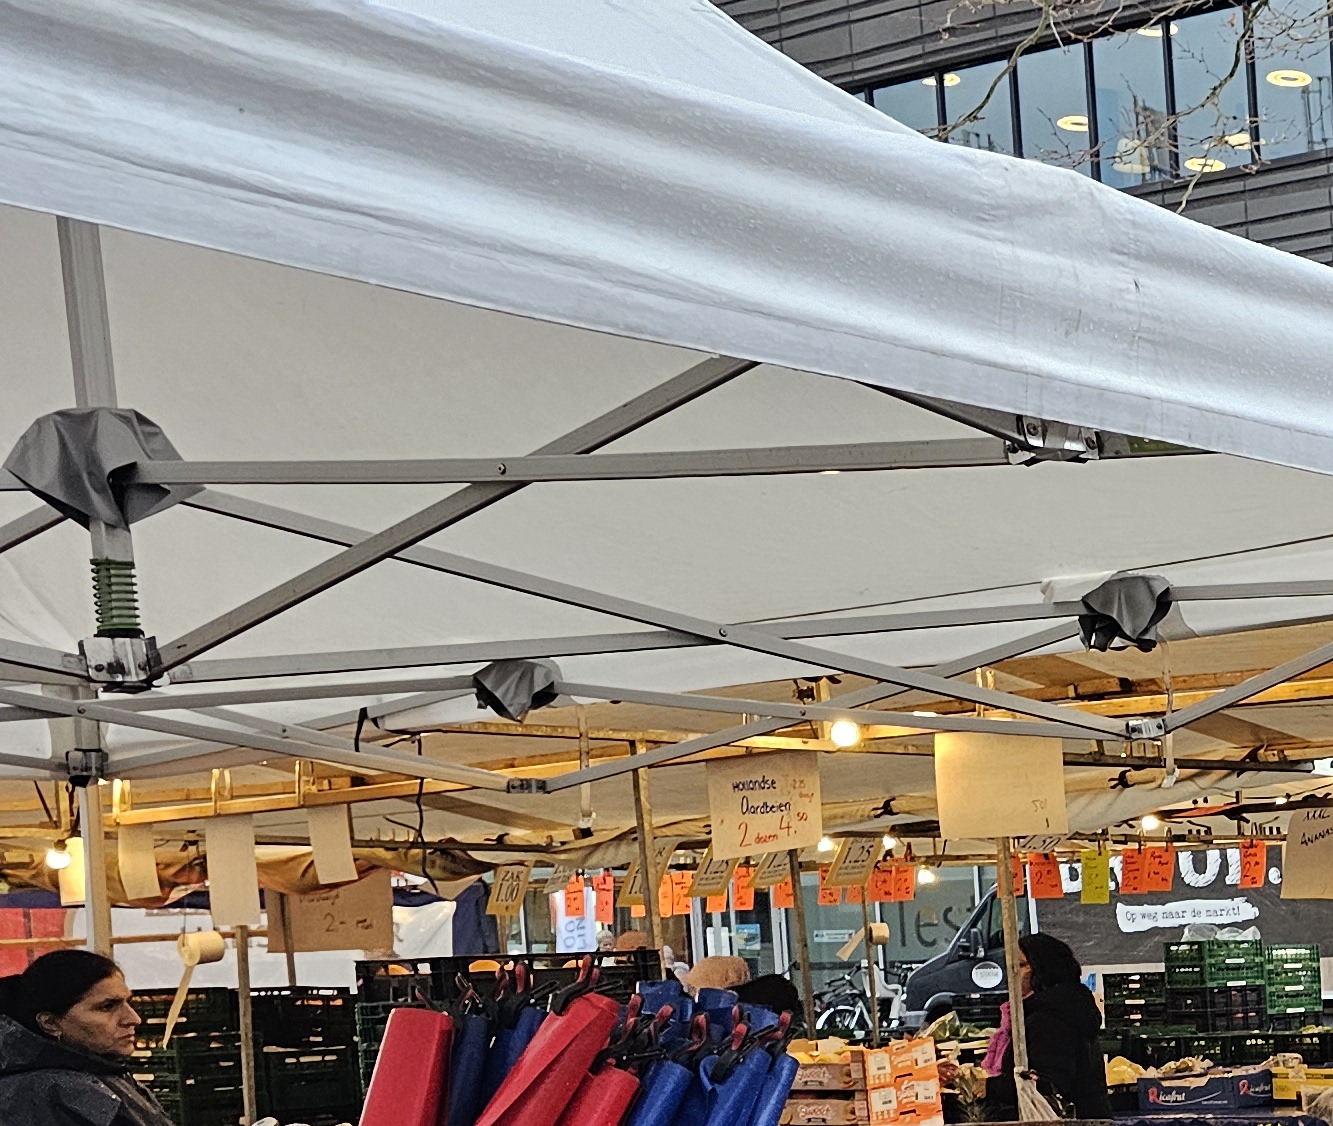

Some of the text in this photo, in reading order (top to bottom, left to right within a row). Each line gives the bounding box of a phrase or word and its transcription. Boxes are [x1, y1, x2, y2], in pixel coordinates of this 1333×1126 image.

[738, 821, 751, 847] 2
[1125, 905, 1241, 923] Op weg naar de markt!
